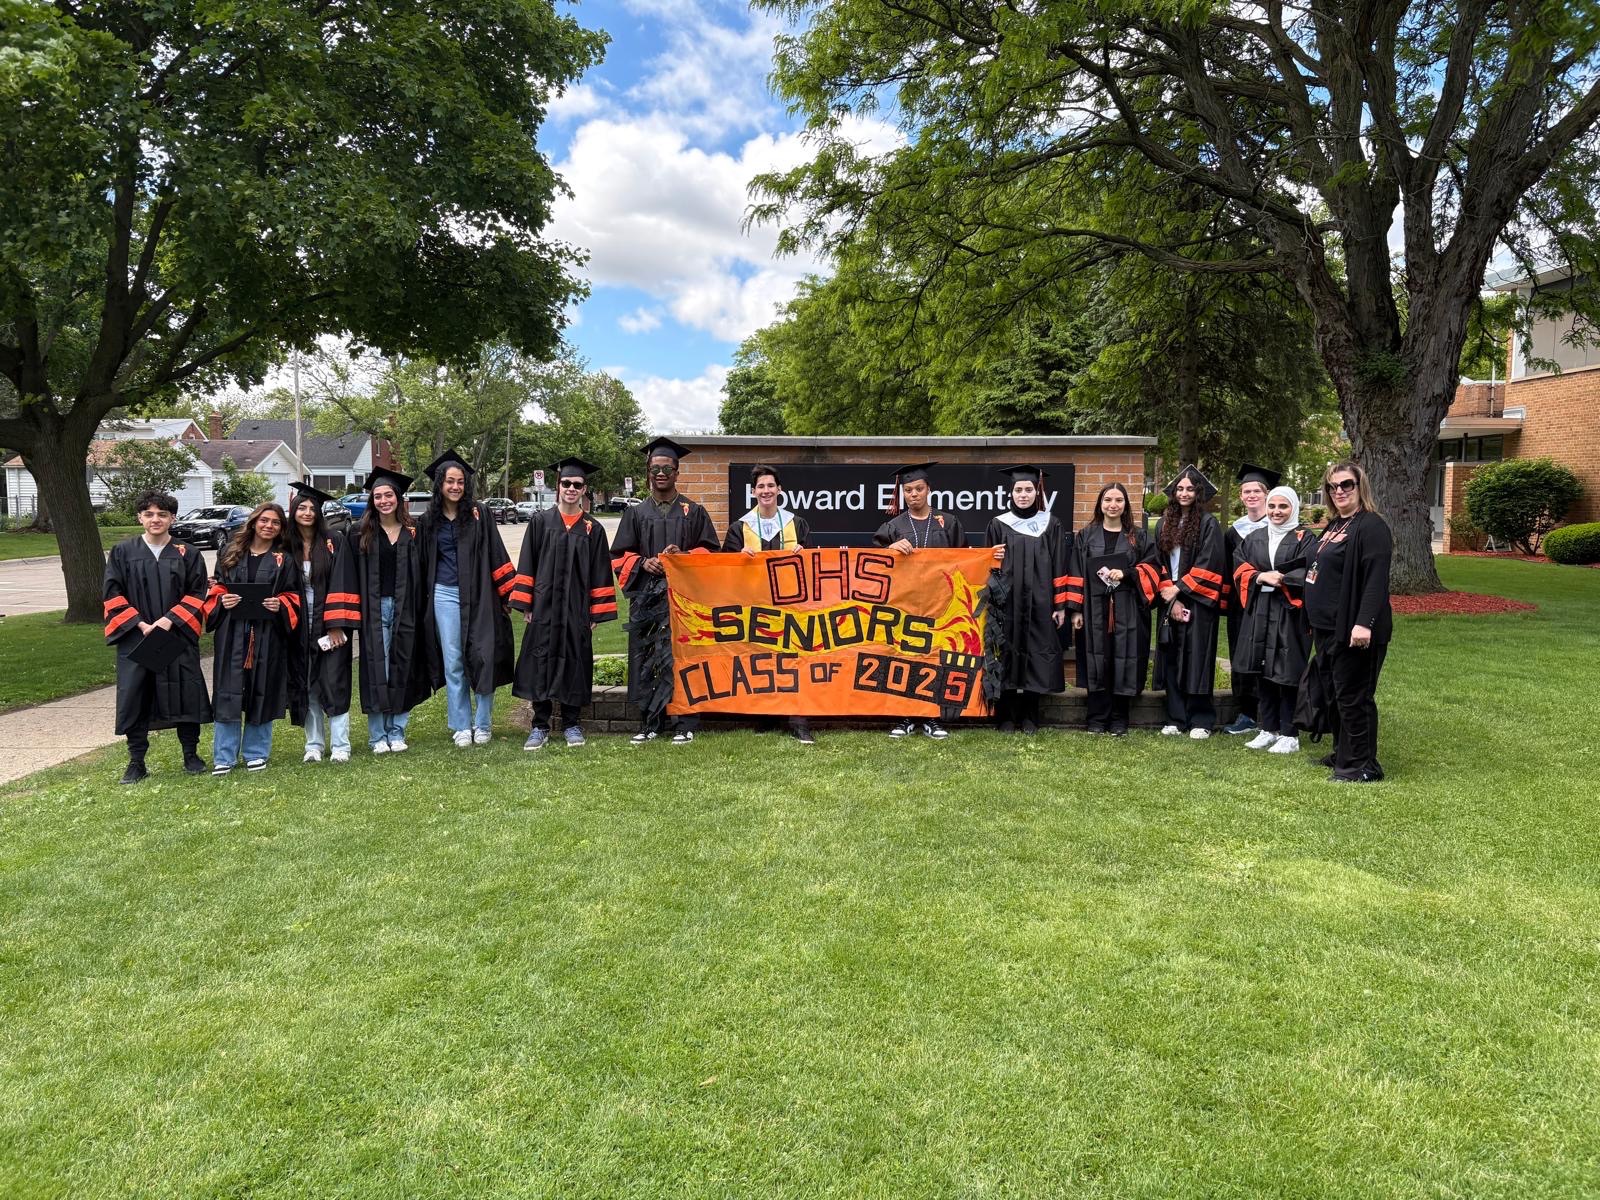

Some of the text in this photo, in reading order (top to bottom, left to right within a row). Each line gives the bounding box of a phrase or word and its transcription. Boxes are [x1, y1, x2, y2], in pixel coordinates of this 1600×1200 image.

[877, 483, 1058, 512] Elmenty
[766, 551, 895, 605] DHS
[711, 605, 936, 655] SENIORS
[678, 652, 968, 706] CLASS OF 2025
